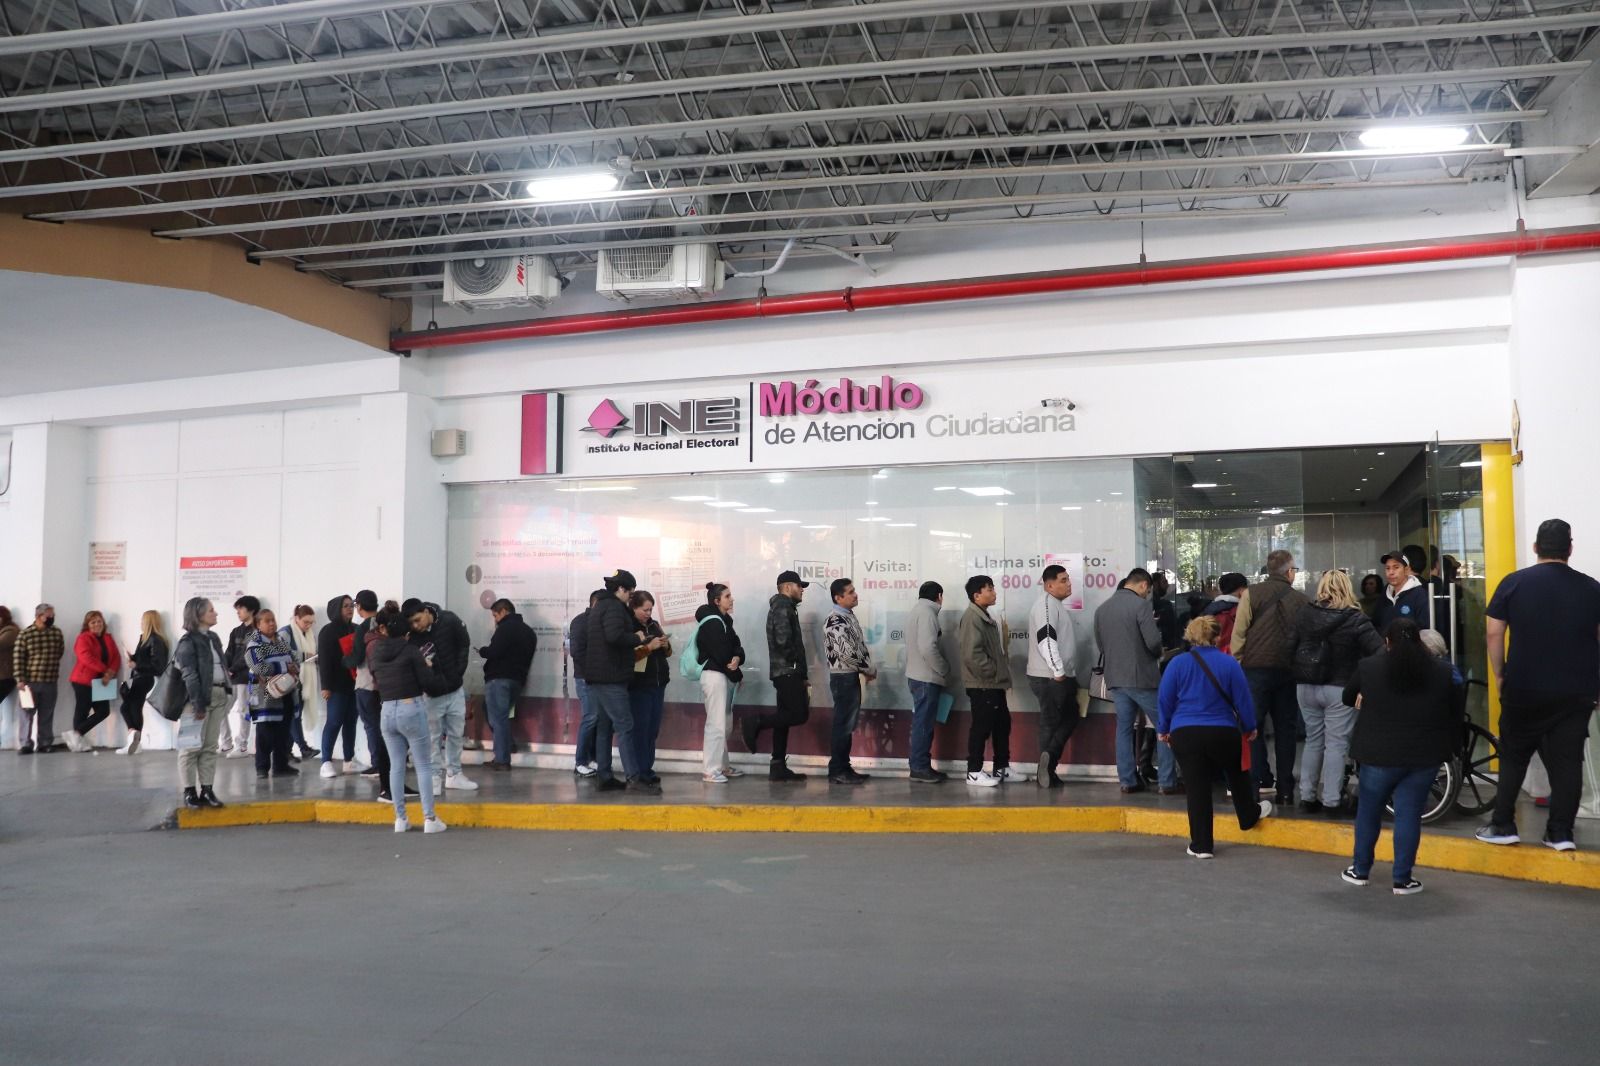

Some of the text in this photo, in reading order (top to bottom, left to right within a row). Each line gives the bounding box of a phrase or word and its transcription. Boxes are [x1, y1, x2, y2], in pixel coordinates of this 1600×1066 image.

[760, 375, 923, 417] Módulo
[633, 397, 740, 437] INE
[765, 423, 796, 445] de
[926, 411, 1075, 437] Ciudadana
[633, 440, 683, 452] Nacional
[686, 437, 739, 449] Electoral
[863, 560, 912, 573] Visita:
[975, 555, 1024, 569] Llama
[797, 566, 844, 578] INEtel
[863, 577, 919, 590] ine.mx
[1001, 574, 1032, 589] 800
